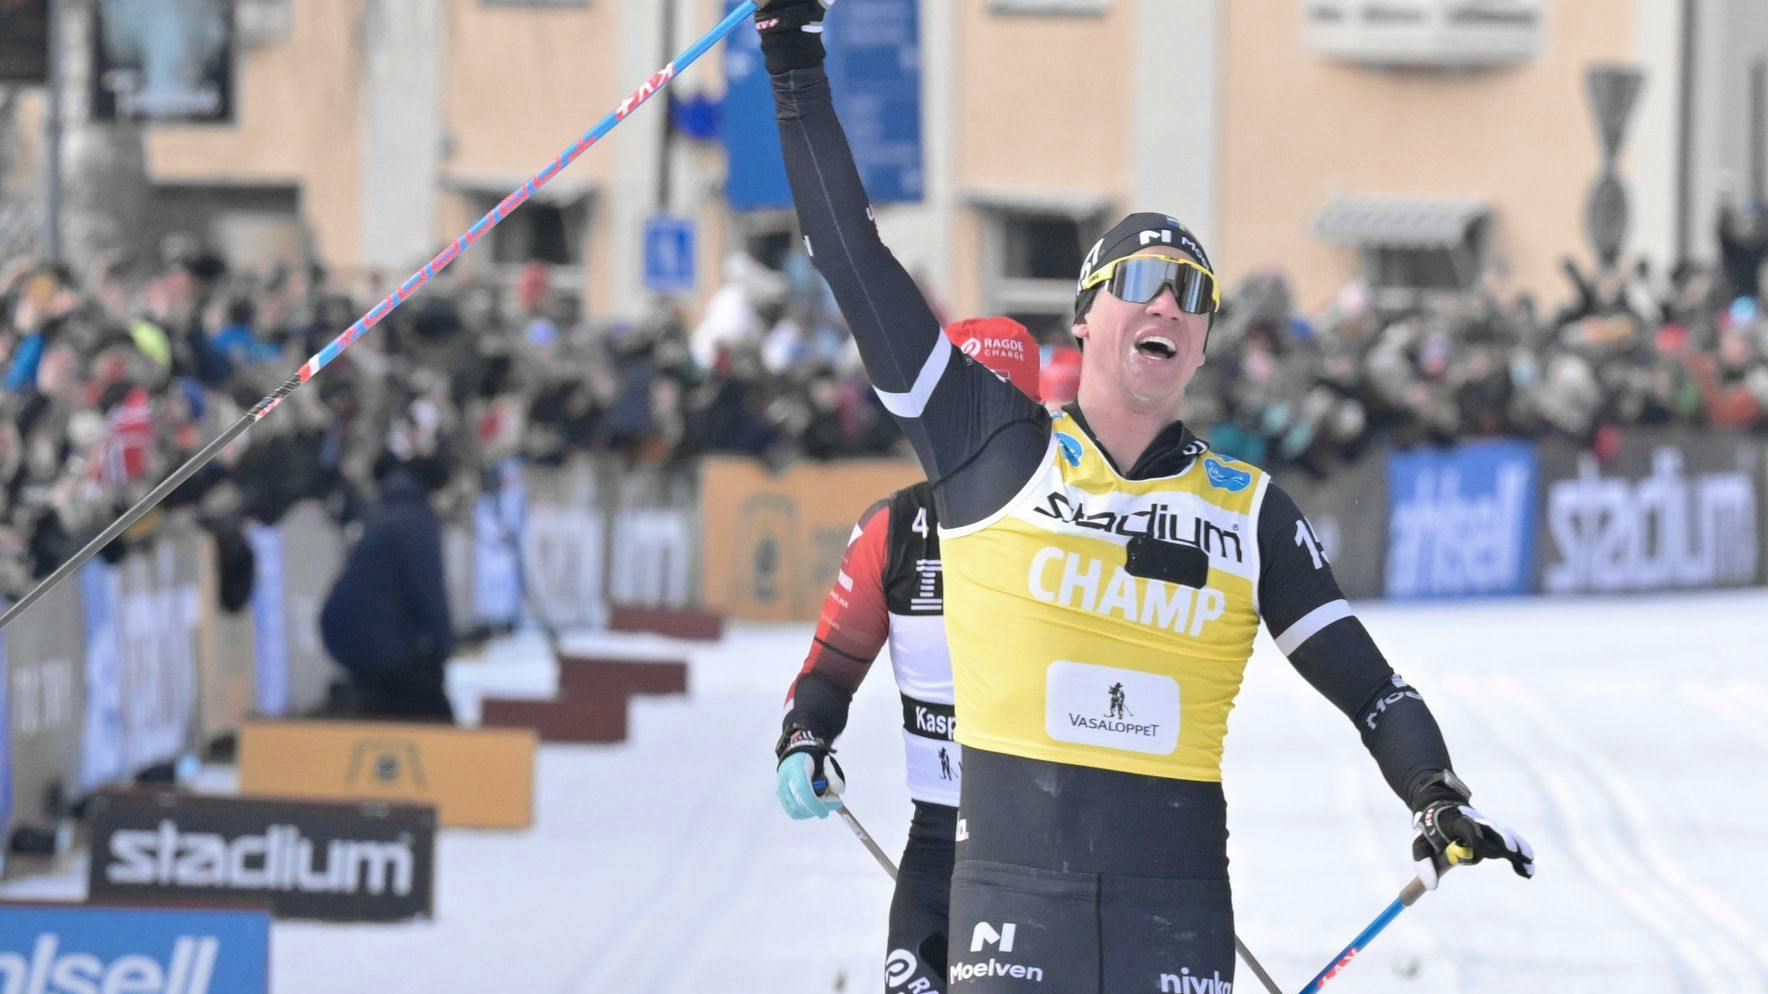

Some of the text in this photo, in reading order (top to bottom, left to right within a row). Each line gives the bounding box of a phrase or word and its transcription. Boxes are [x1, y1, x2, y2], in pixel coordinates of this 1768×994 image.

[984, 338, 1024, 352] RAGDE
[1028, 546, 1226, 637] CHAMP
[1069, 713, 1160, 738] VASALOPPET
[106, 819, 414, 898] stadium
[950, 958, 1044, 985] Moelven
